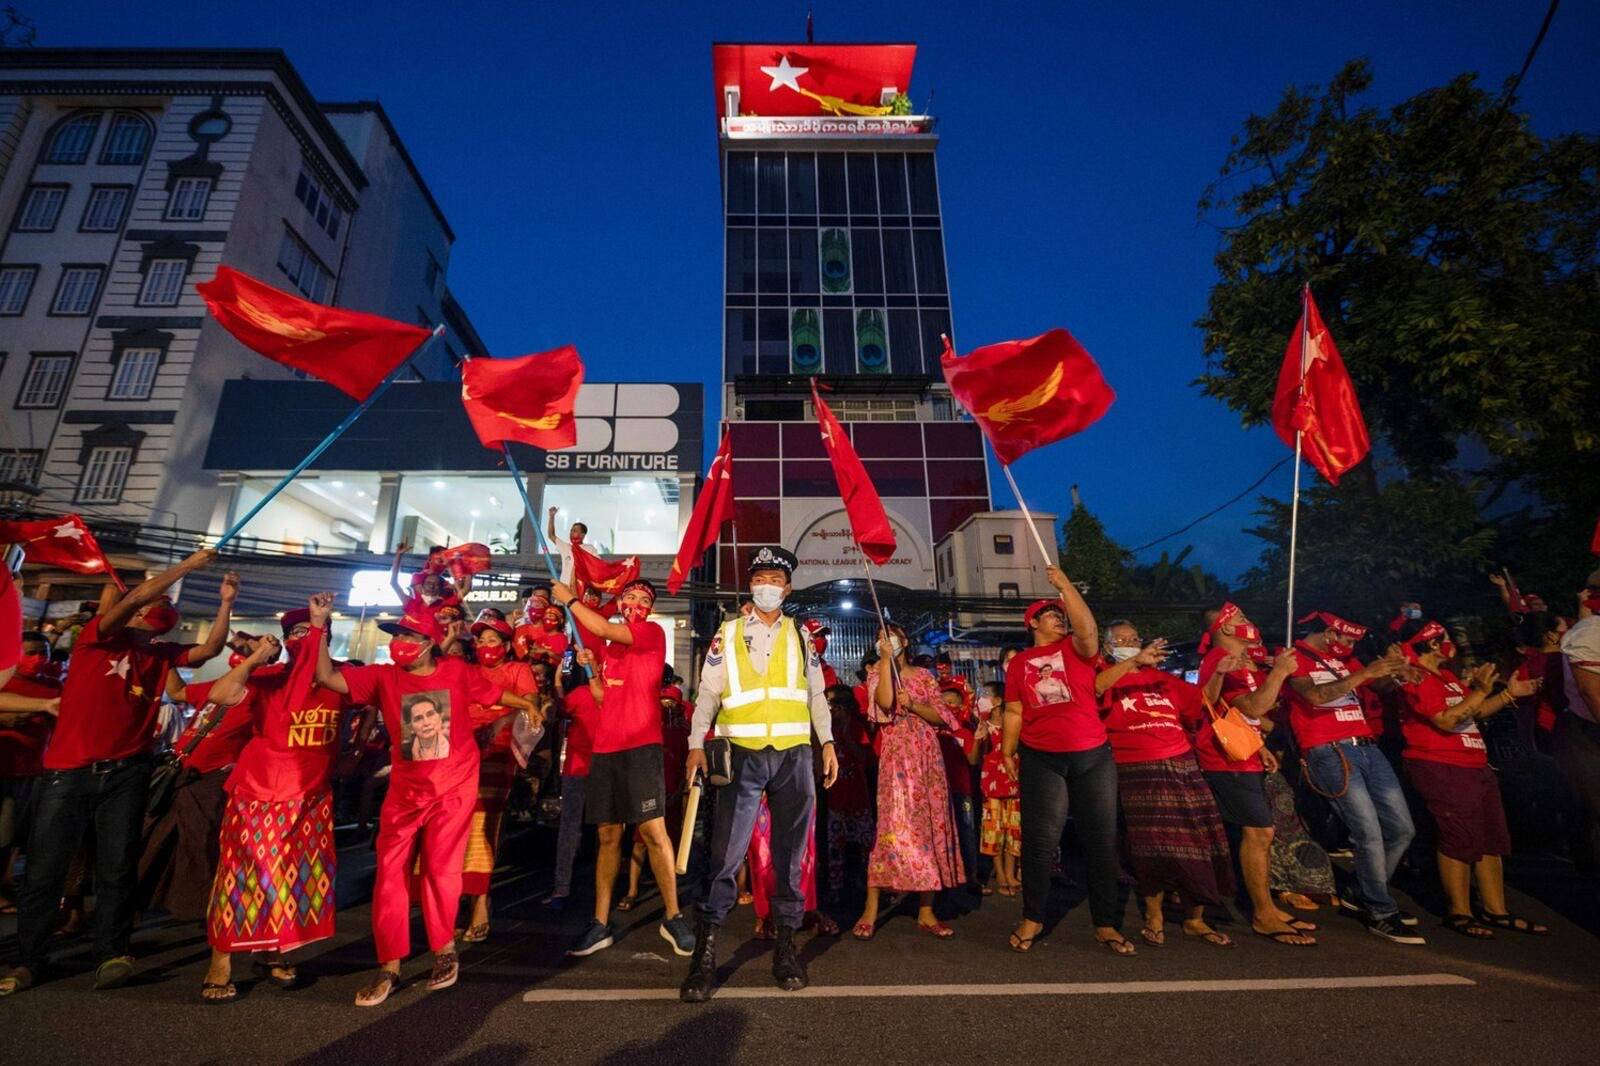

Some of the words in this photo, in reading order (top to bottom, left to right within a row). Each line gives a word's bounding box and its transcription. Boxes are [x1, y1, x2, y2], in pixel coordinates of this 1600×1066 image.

[545, 454, 570, 470] SB
[576, 454, 679, 470] FURNITURE
[799, 558, 831, 566] NATIONAL
[832, 558, 859, 566] LEAGUE
[290, 706, 341, 724] VOTE
[288, 727, 337, 748] NLD
